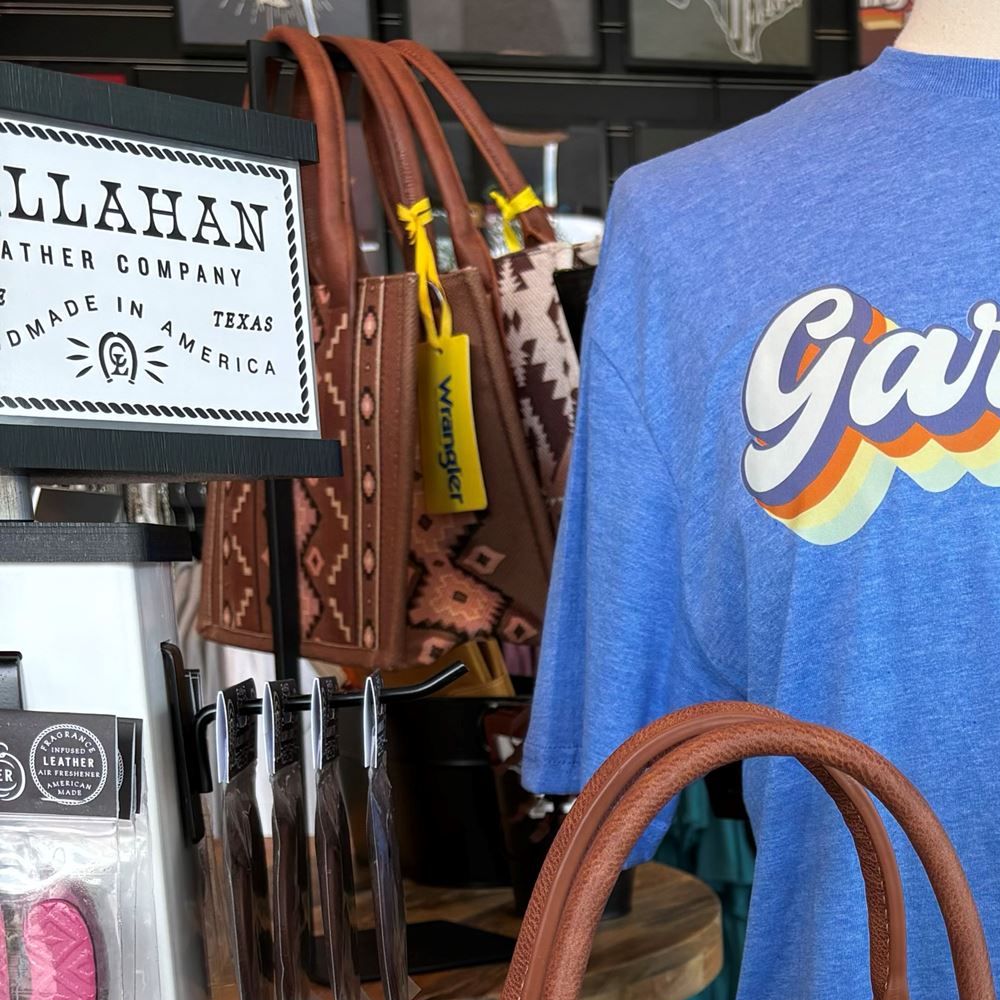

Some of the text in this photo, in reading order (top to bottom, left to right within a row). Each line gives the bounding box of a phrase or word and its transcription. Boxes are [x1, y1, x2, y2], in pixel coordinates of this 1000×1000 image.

[0, 165, 268, 252] LLAHAN
[117, 254, 241, 287] COMPANY
[213, 310, 273, 332] TEXAS
[0, 294, 276, 376] DMADE IN AMERICA
[437, 375, 463, 504] Wrangler
[40, 730, 96, 754] FRAGRANCE
[51, 747, 86, 755] INFUSED
[43, 756, 95, 768] LEATHER
[54, 770, 101, 778] FRESHENER
[47, 781, 92, 791] AMERICAN
